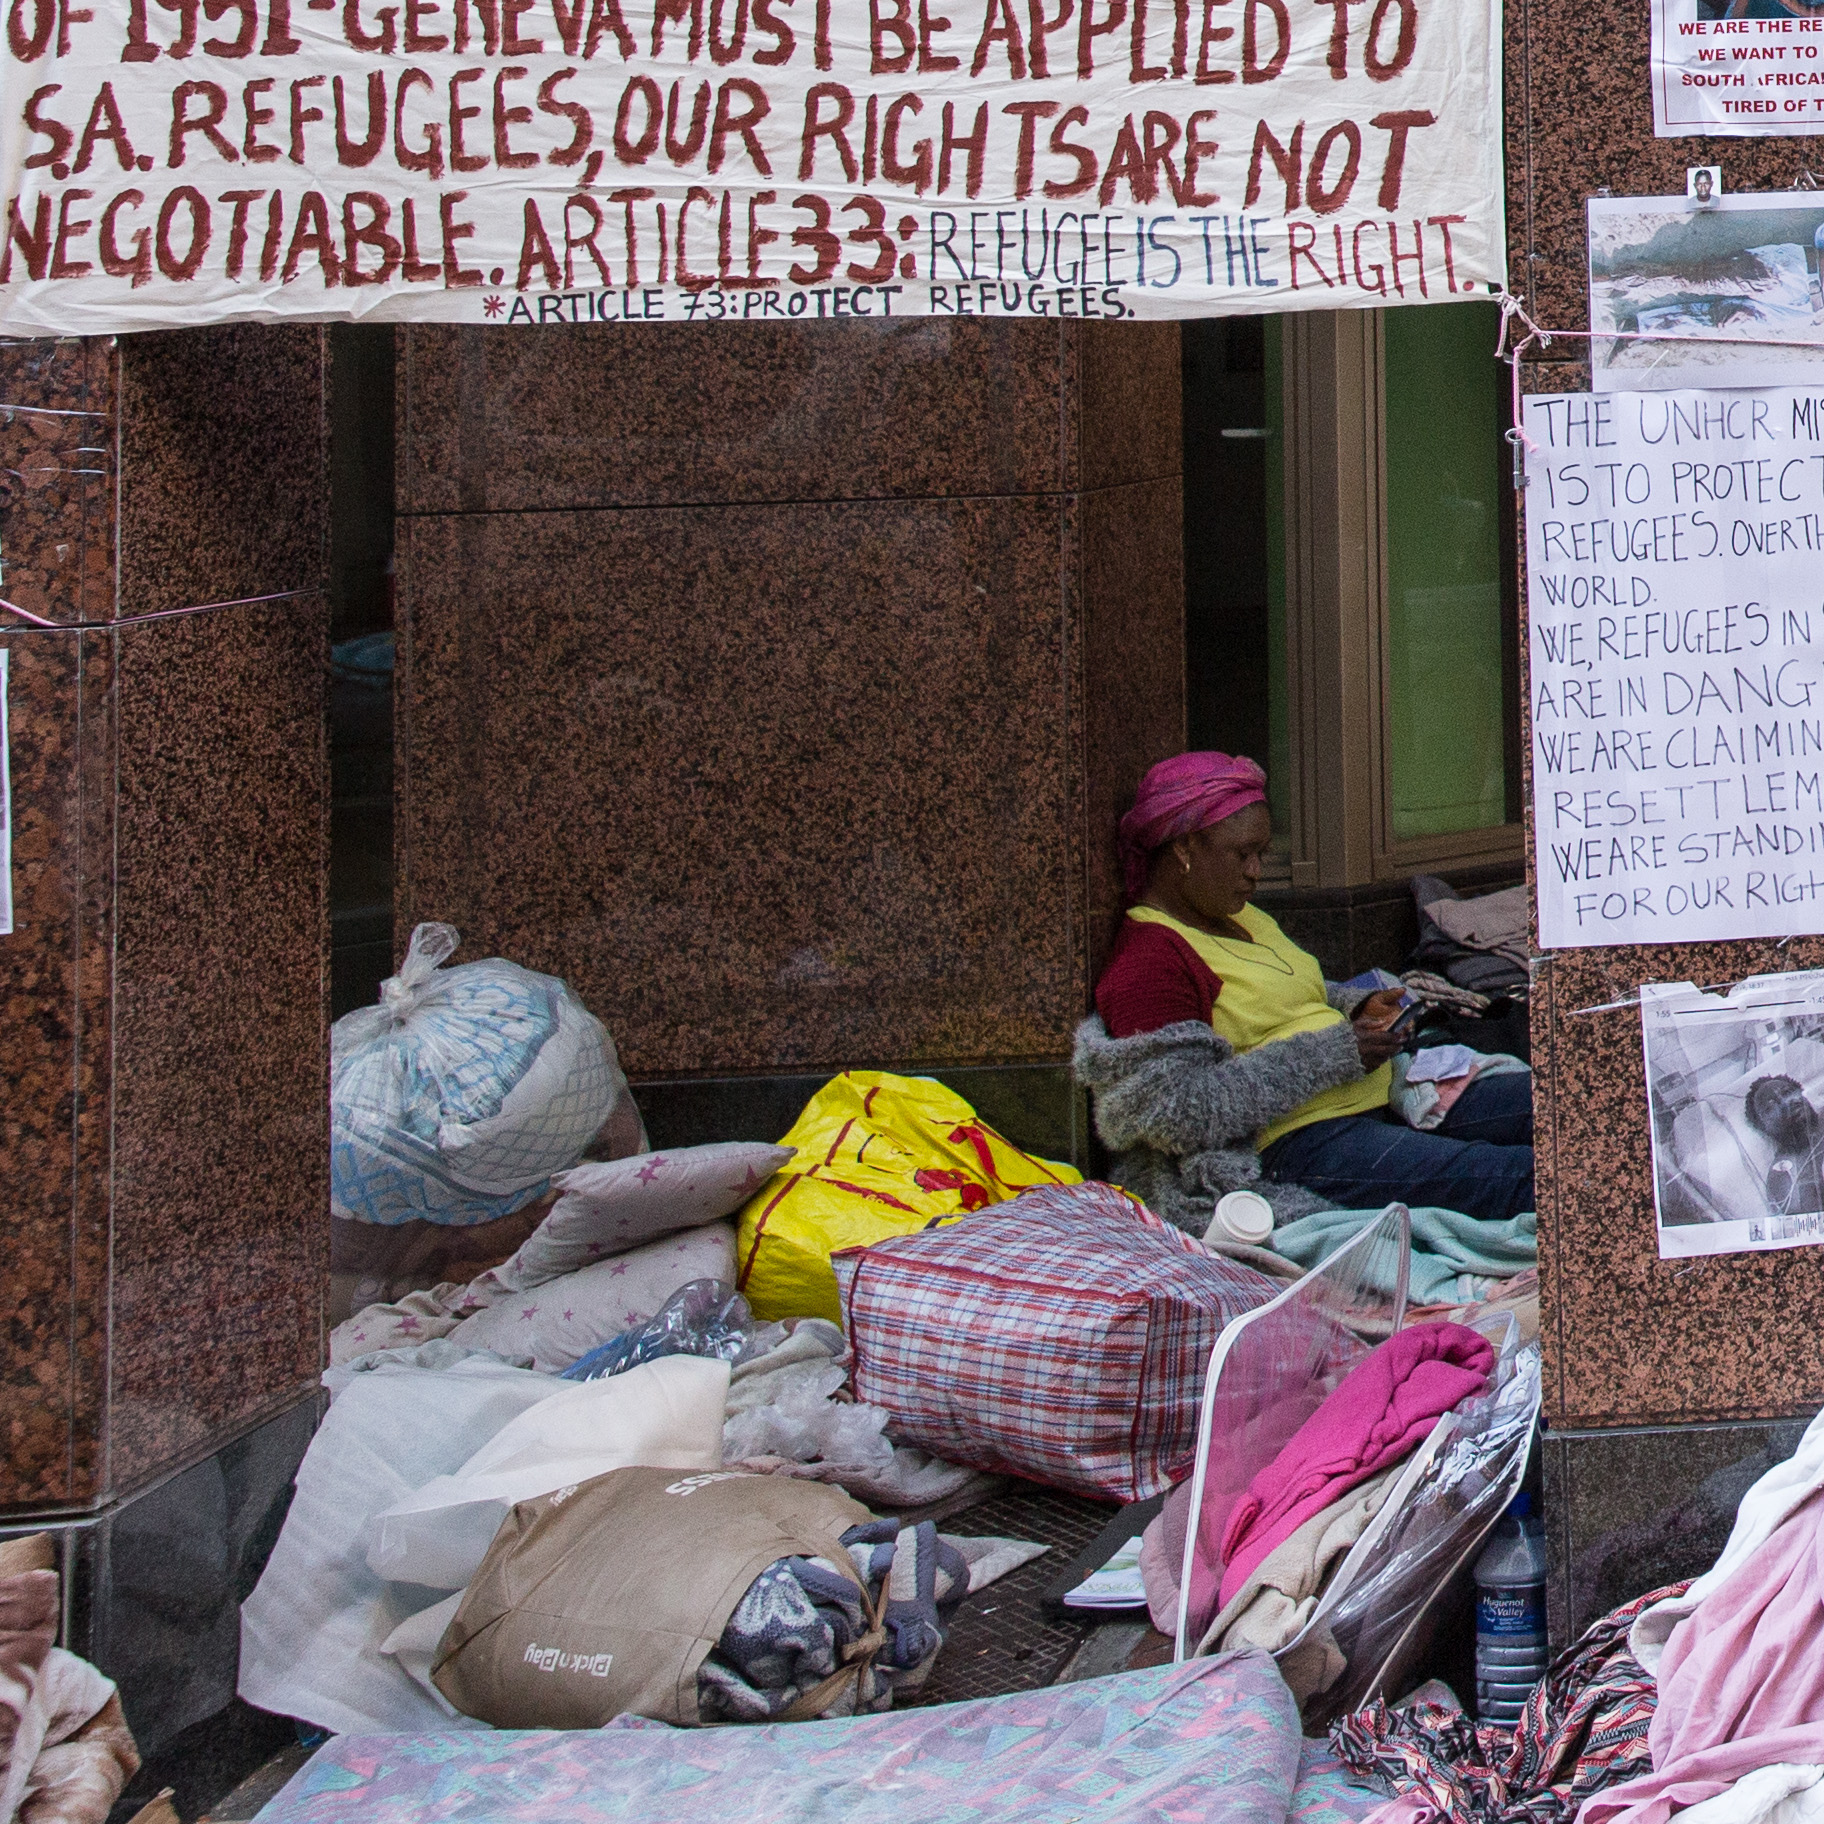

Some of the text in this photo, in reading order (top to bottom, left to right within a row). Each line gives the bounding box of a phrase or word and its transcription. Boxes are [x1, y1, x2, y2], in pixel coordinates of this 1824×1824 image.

[1678, 22, 1707, 35] WE
[1713, 21, 1750, 35] ARE
[1756, 20, 1793, 33] THE
[1698, 48, 1727, 62] WE
[1732, 46, 1787, 60] WANT
[1793, 45, 1818, 59] TO
[1681, 73, 1746, 88] SOUTH
[1722, 99, 1777, 114] TIRED
[1783, 98, 1808, 113] OF
[168, 65, 606, 188] REFUGEES,
[612, 73, 774, 180] OUR
[798, 80, 1099, 203] RIGHTS
[1099, 108, 1221, 210] ARE
[1240, 108, 1440, 220] NOT
[0, 185, 506, 290] NEGOTIABLE.
[517, 185, 782, 295] ARTICLE
[928, 207, 1130, 291] REFUGEE
[1134, 213, 1183, 289] IS
[1195, 213, 1281, 291] THE
[1286, 213, 1478, 300] RIGHT.
[928, 284, 1136, 320] REFUGEES.
[1532, 398, 1618, 448] THE
[1638, 398, 1775, 447] UNHCR
[1546, 463, 1591, 509] IS
[1594, 462, 1652, 508] TO
[1541, 509, 1724, 564] REFUGEES.
[1730, 517, 1798, 558] OVER
[1539, 573, 1658, 609] WORLD.
[1597, 600, 1770, 662] REFUGEES
[1781, 608, 1812, 647] IN
[1535, 677, 1607, 722] ARE
[1617, 676, 1648, 717] IN
[1538, 730, 1586, 775] WE
[1590, 728, 1658, 773] ARE
[1550, 837, 1603, 884] WE
[1607, 835, 1669, 876] ARE
[1573, 886, 1658, 927] FOR
[1665, 875, 1734, 916] OUR
[1497, 1607, 1525, 1619] Valley
